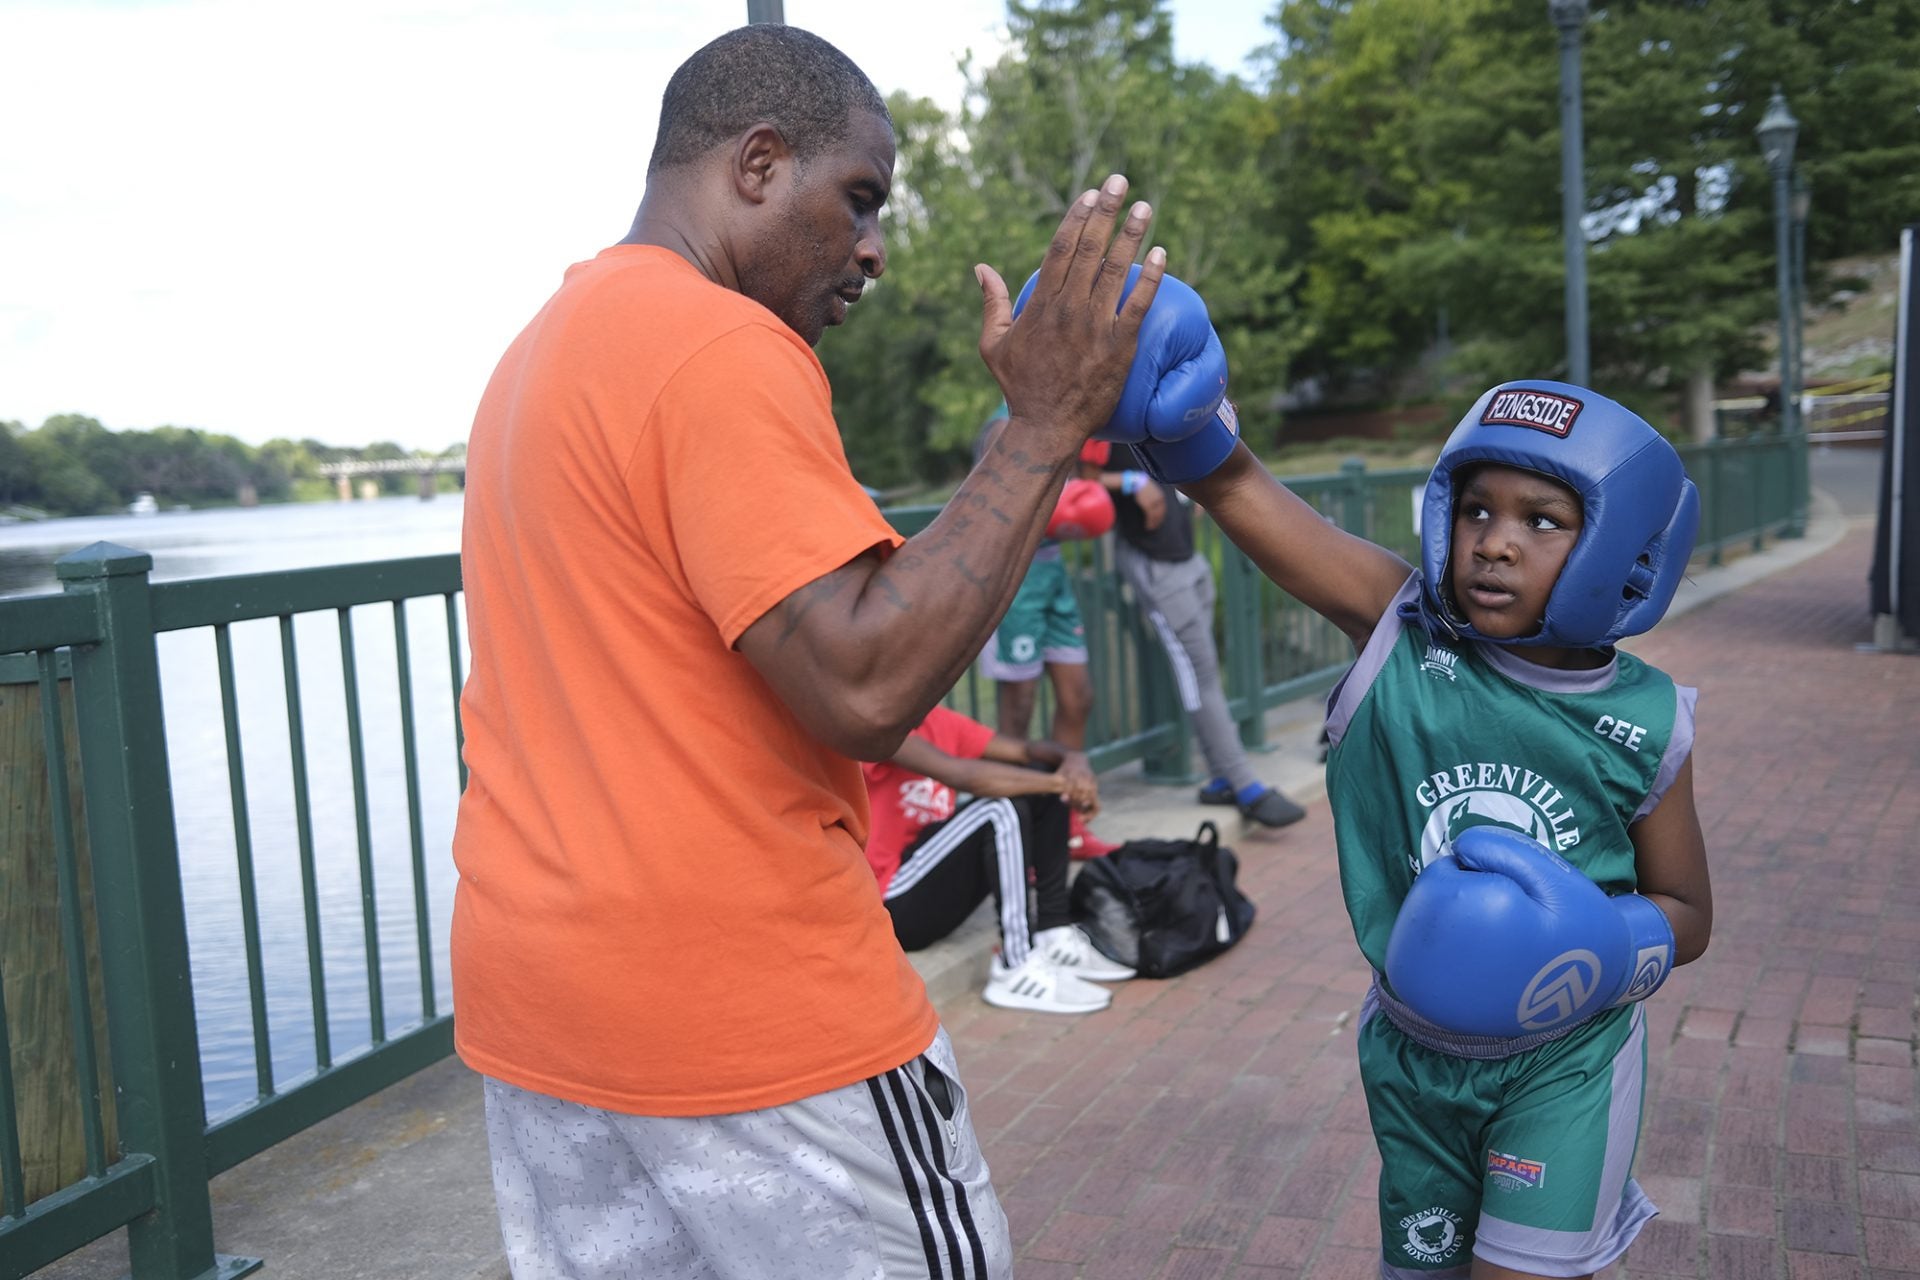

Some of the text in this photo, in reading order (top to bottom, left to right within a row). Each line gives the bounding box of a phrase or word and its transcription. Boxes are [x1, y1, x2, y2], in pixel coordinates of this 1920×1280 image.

[1489, 392, 1577, 431] RINGSIDE
[1424, 645, 1459, 667] JIMMY
[1593, 714, 1647, 752] CEE
[1415, 762, 1580, 851] GREENVILLE
[1400, 1206, 1463, 1229] GREENVILLE
[1402, 1234, 1464, 1263] BOXING CLUB
